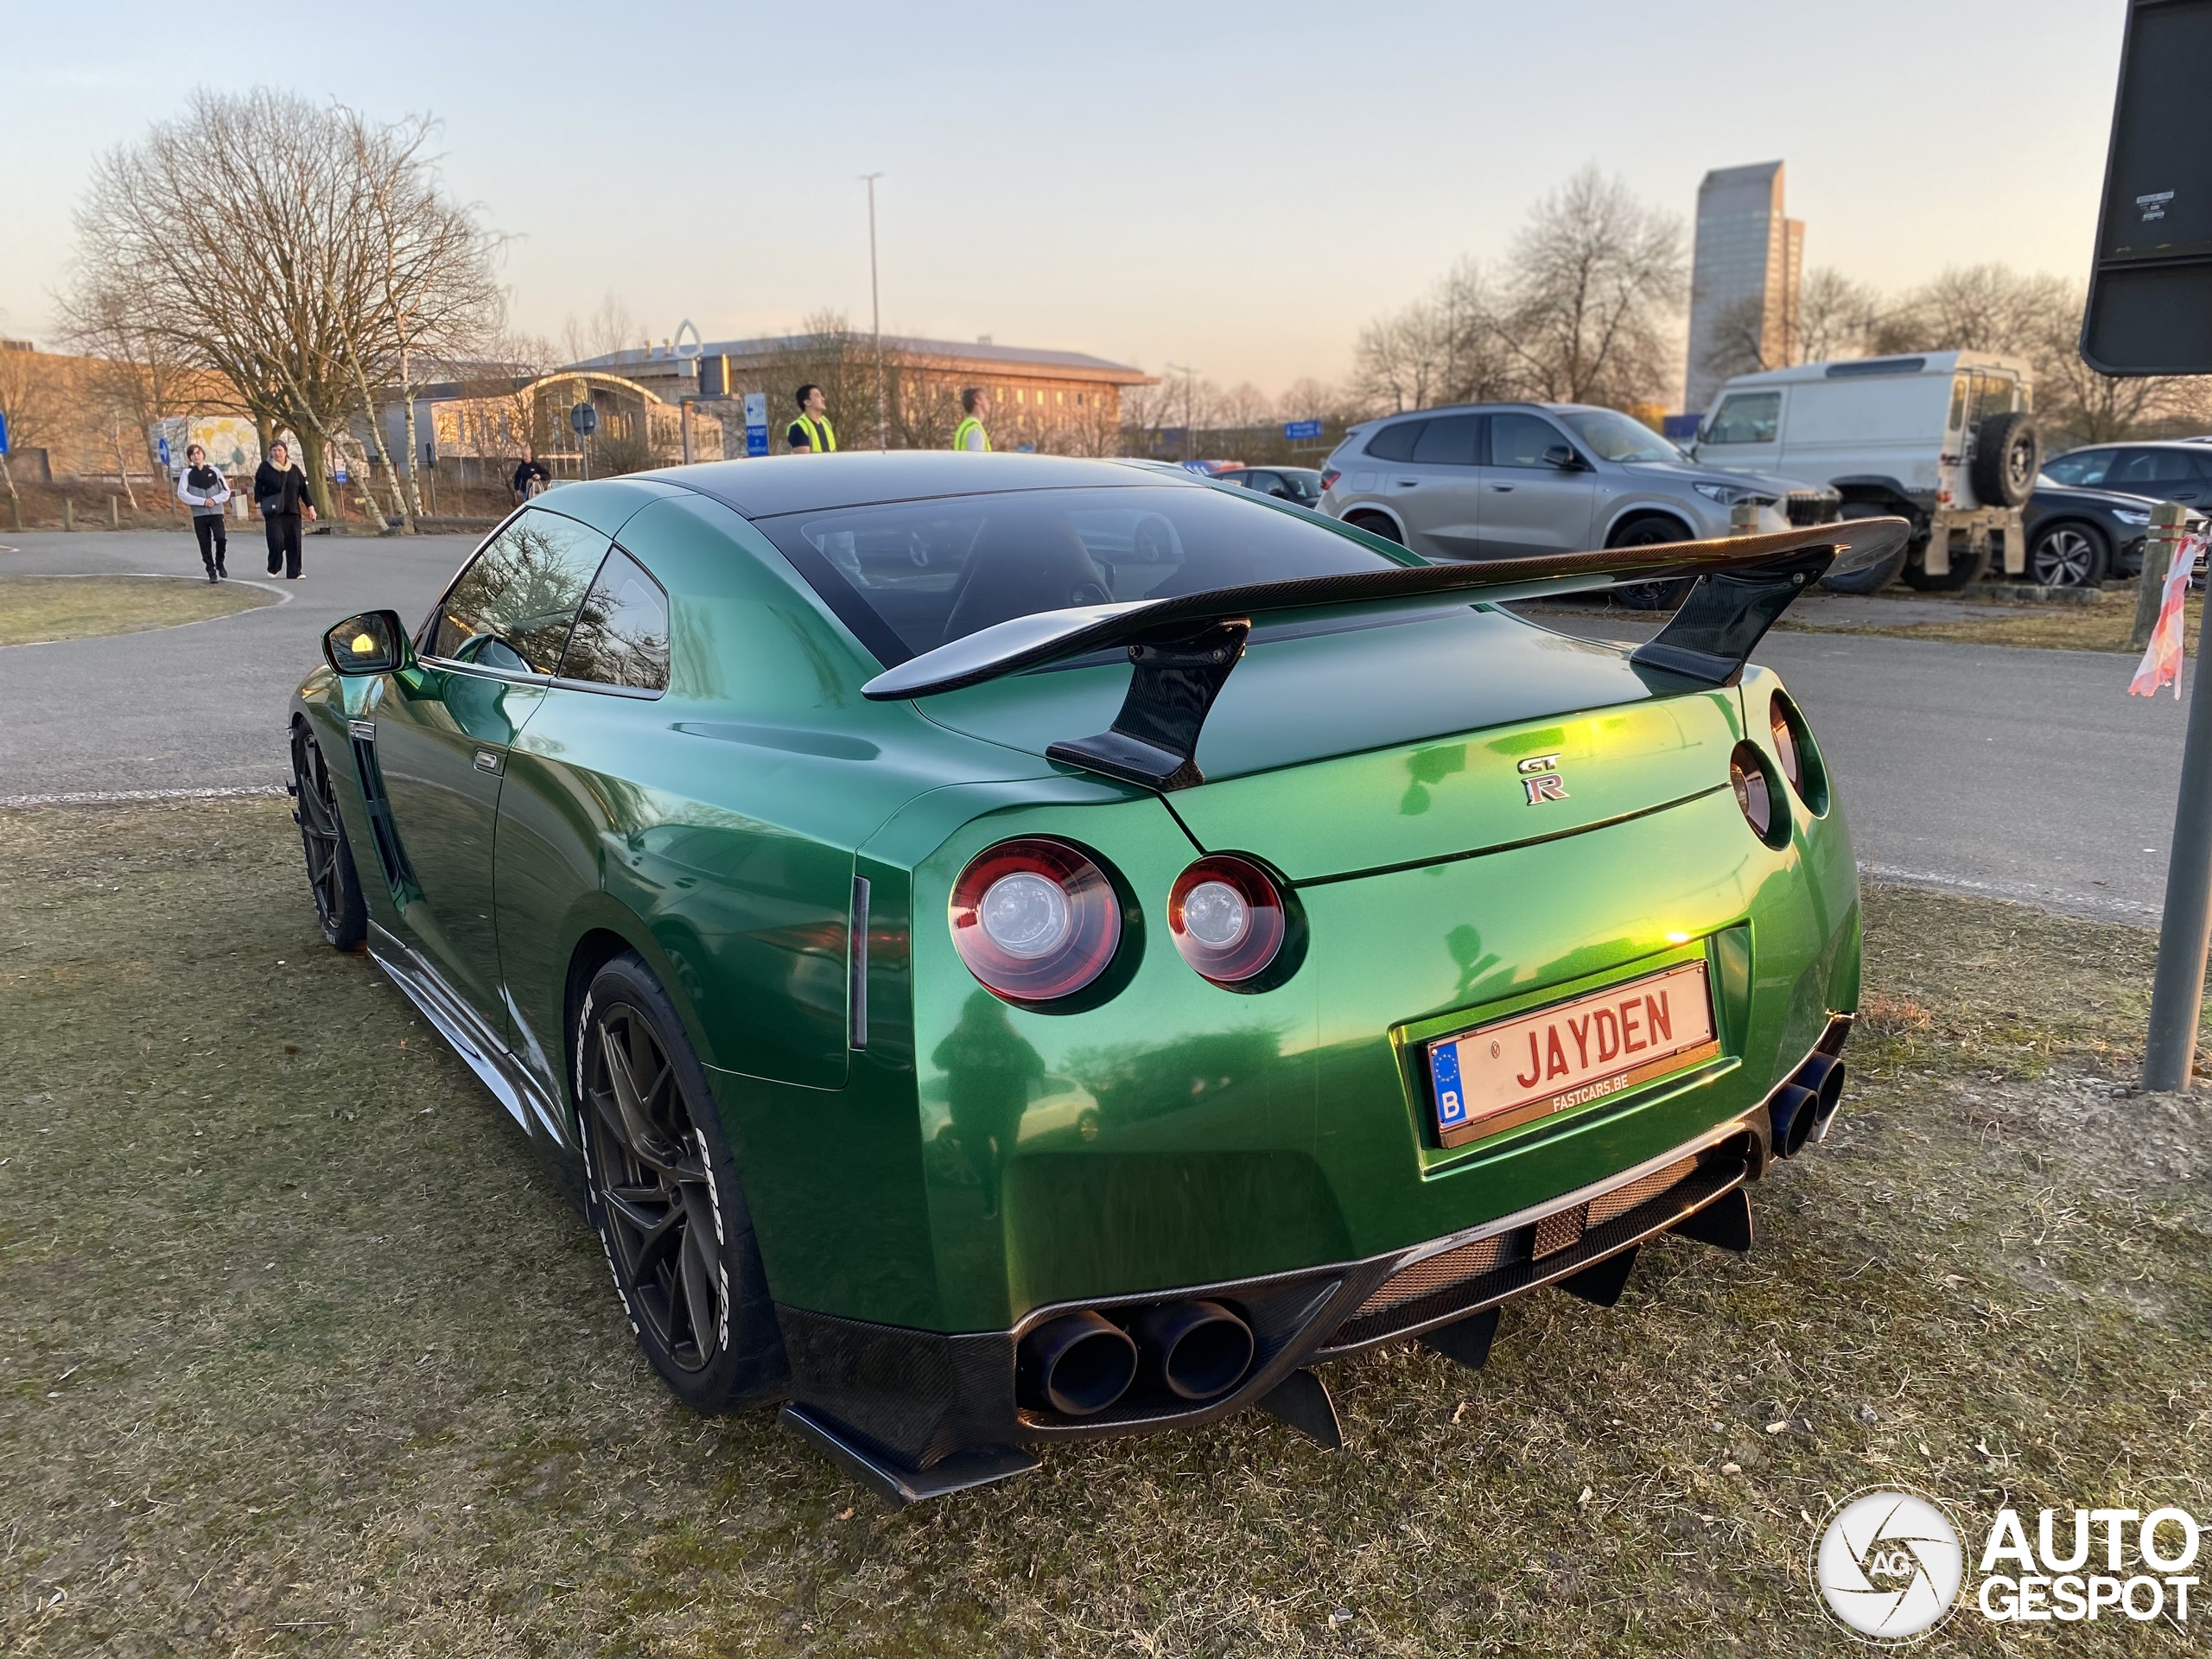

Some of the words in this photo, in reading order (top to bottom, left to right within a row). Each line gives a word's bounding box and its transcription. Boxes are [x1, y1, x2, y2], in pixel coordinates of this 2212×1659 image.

[1517, 753, 1561, 774] GT
[1521, 772, 1570, 806] R
[1516, 987, 1673, 1089] JAYDEN
[1441, 1090, 1459, 1119] B
[1553, 1074, 1630, 1113] FASTCARS.BE
